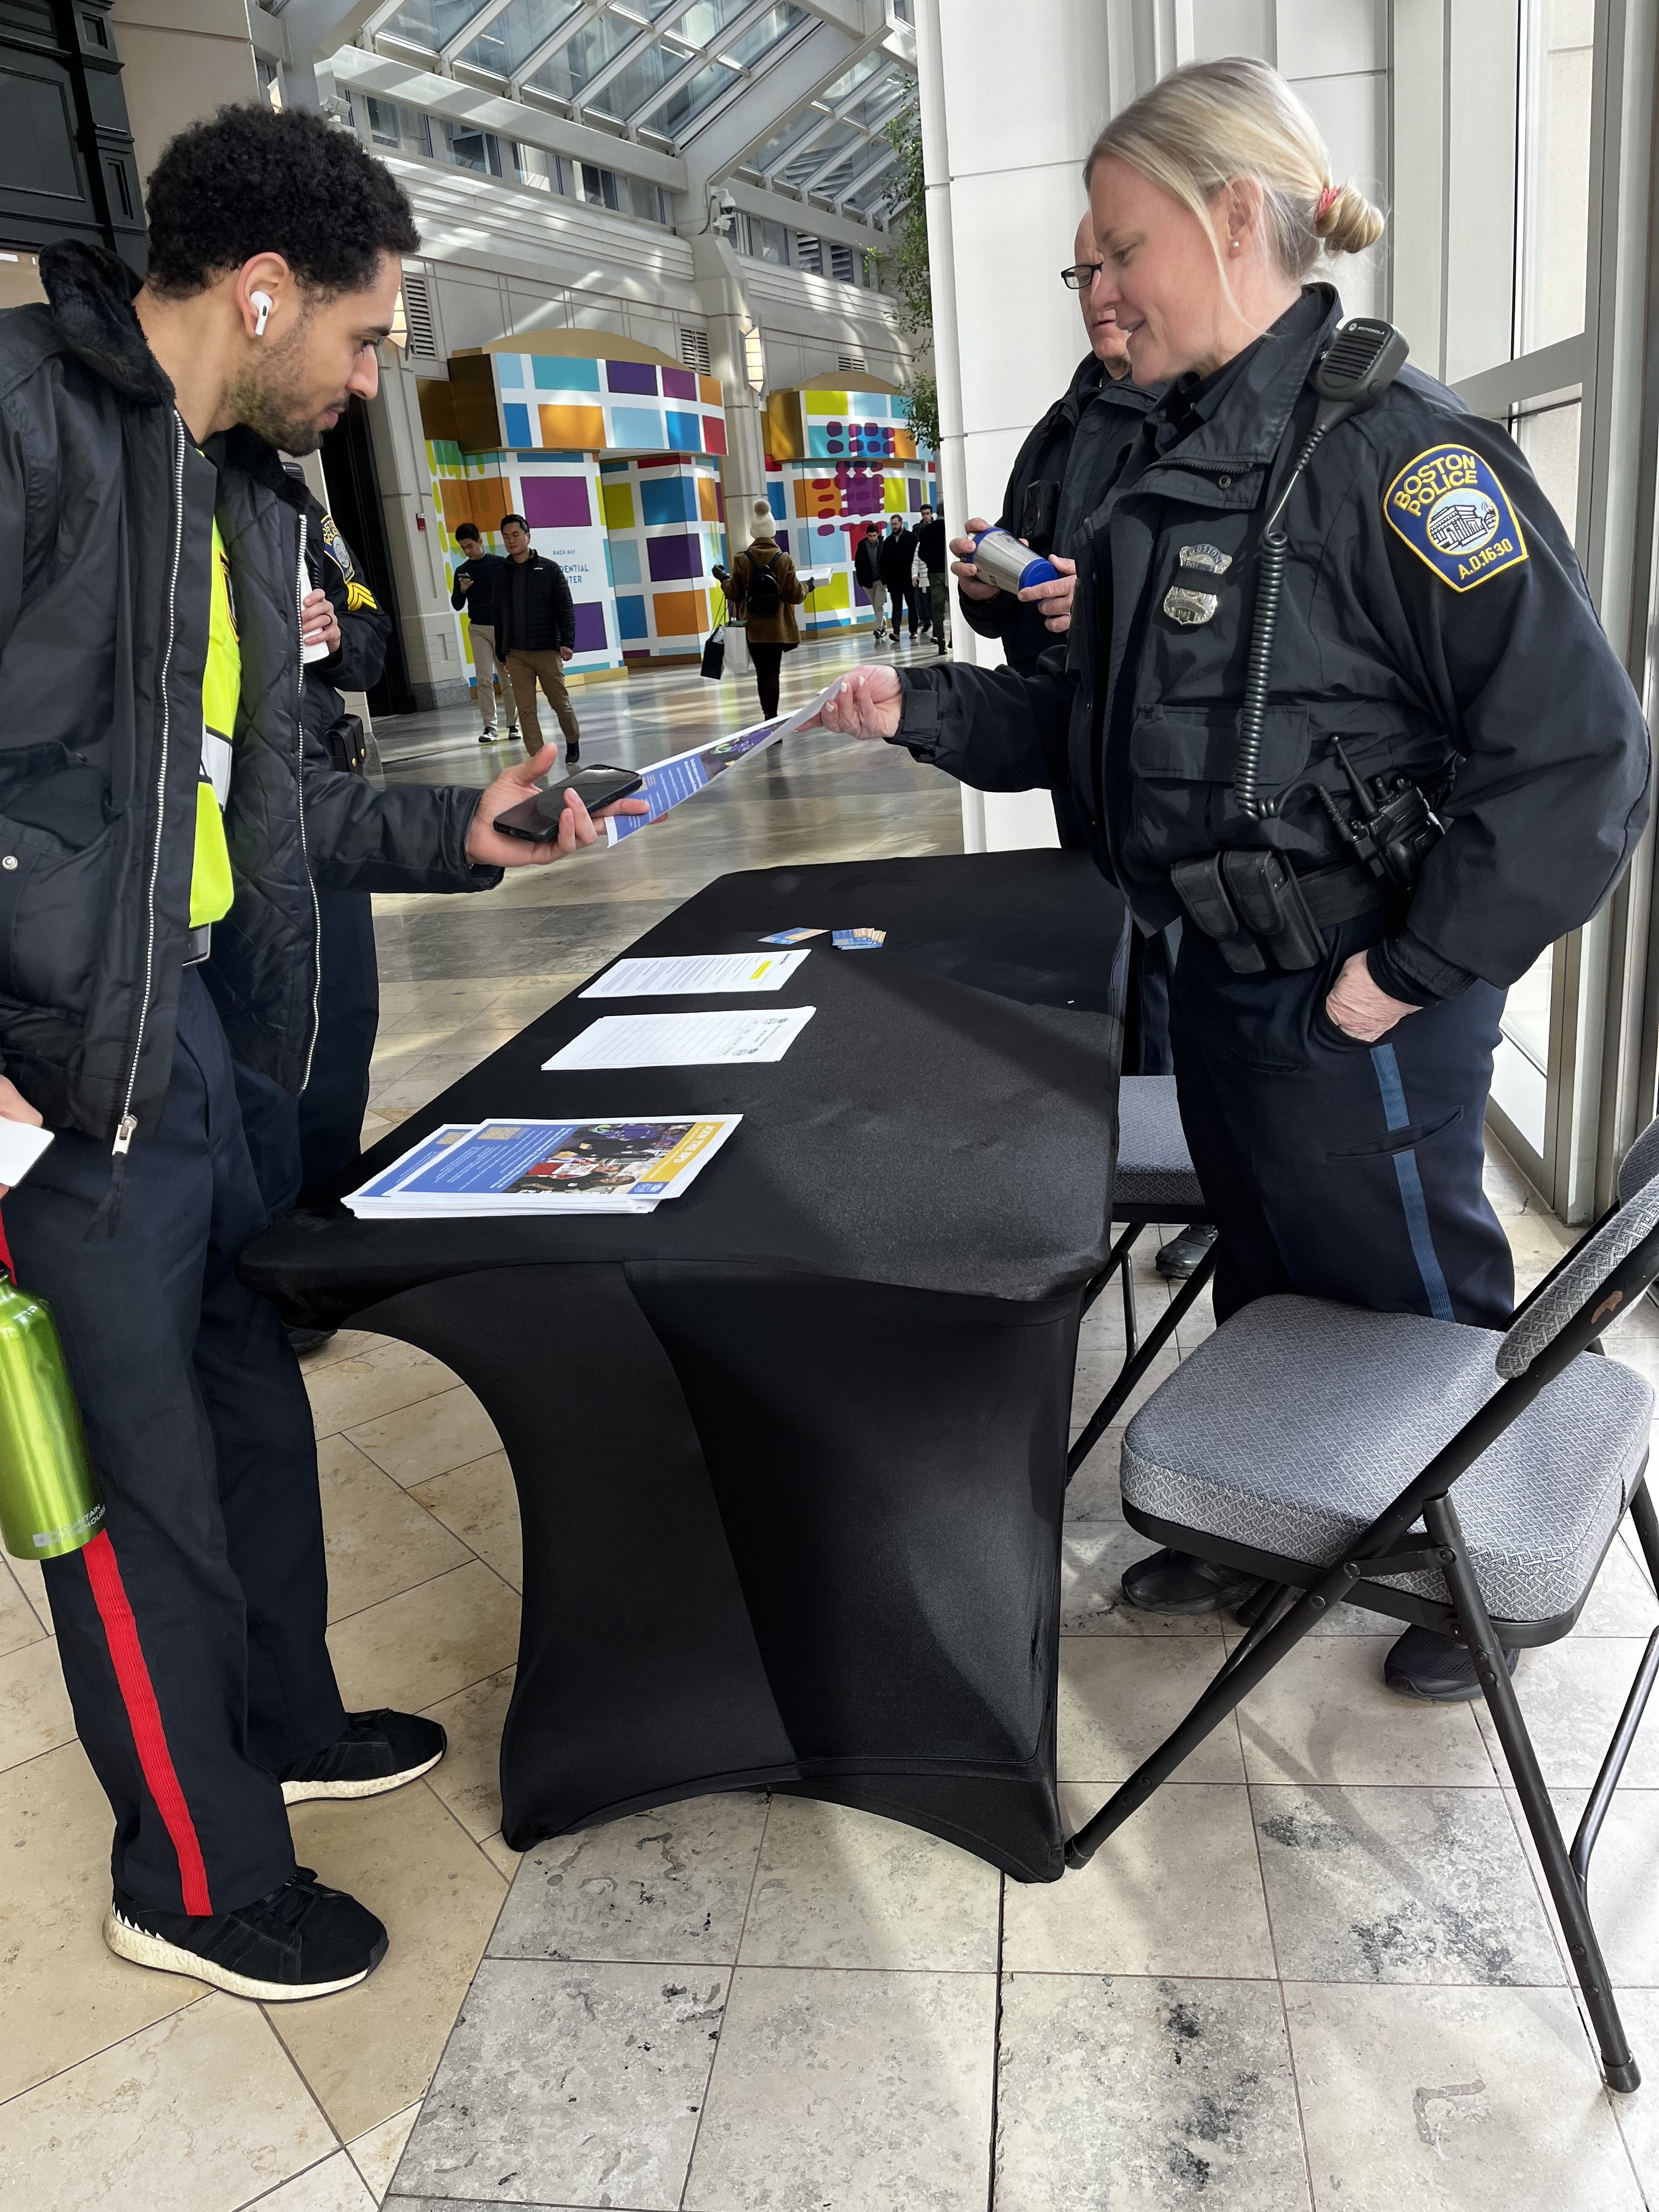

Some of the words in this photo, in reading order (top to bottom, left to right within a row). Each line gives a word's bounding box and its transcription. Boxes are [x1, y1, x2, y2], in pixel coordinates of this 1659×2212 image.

[1357, 326, 1385, 335] MOTOROLA
[1393, 454, 1476, 510] BOSTON
[1406, 470, 1478, 517] POLICE
[559, 564, 589, 573] DENTIAL
[567, 575, 582, 584] TER
